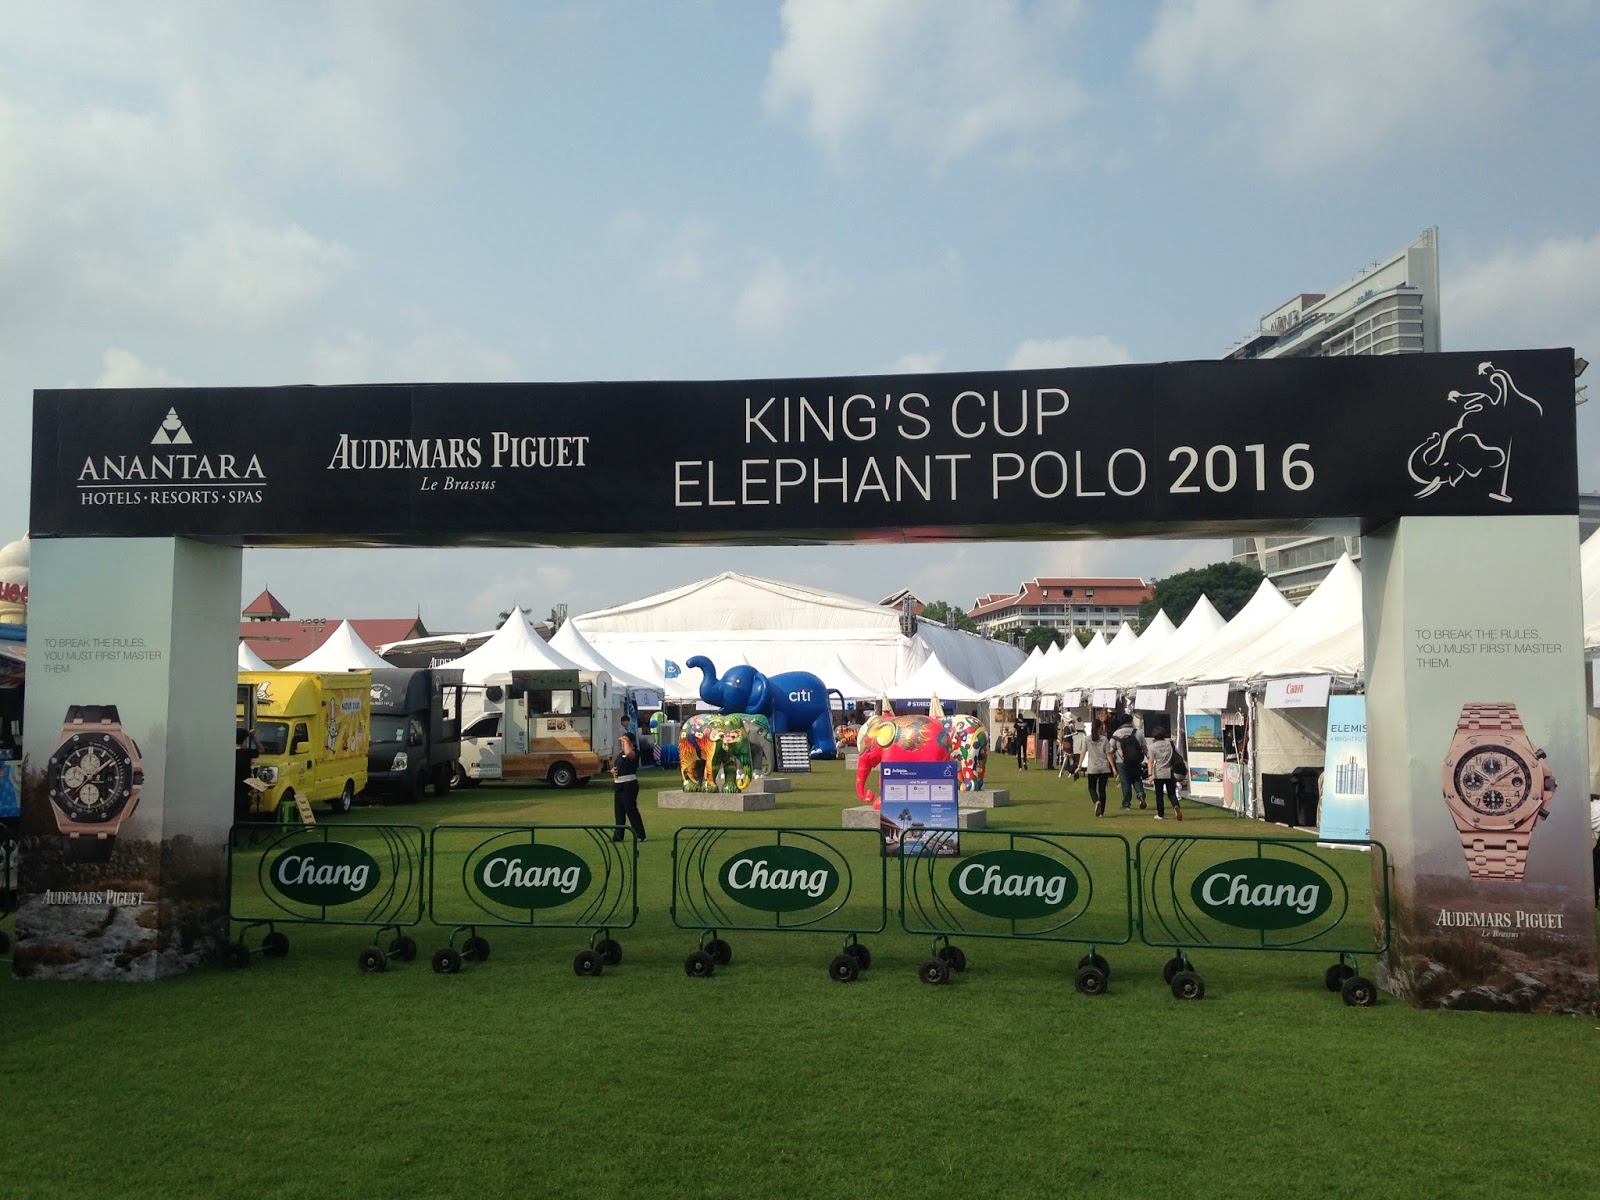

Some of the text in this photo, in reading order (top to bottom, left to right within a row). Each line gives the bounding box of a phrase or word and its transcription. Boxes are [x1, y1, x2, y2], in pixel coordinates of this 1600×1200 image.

[745, 388, 1070, 443] KING'S CUP
[327, 431, 589, 470] AUDEMARS PIGUET
[77, 453, 266, 481] ANANTARA
[674, 443, 1315, 507] ELEPHANT POLO 2016
[420, 476, 496, 491] Le Brassus
[44, 638, 57, 648] TO
[59, 638, 90, 648] BREAK
[93, 638, 111, 648] THE
[1416, 629, 1542, 640] TO BREAK THE RULES.
[44, 651, 162, 661] YOU MUST FIRST MASTER
[1416, 643, 1562, 654] YOU MUST FIRST MASTER
[1416, 657, 1452, 668] THEM.
[788, 689, 811, 702] citi
[1331, 724, 1367, 733] ELEMIS
[277, 854, 371, 891] Chang
[482, 857, 582, 894] Chang
[727, 858, 829, 898] Chang
[957, 863, 1068, 904] Chang
[42, 889, 145, 905] AUDEMARS PIGUET
[1201, 873, 1321, 915] Chang
[1436, 909, 1564, 929] AUDEMARS PIGUET
[1481, 929, 1519, 938] Le Brassus
